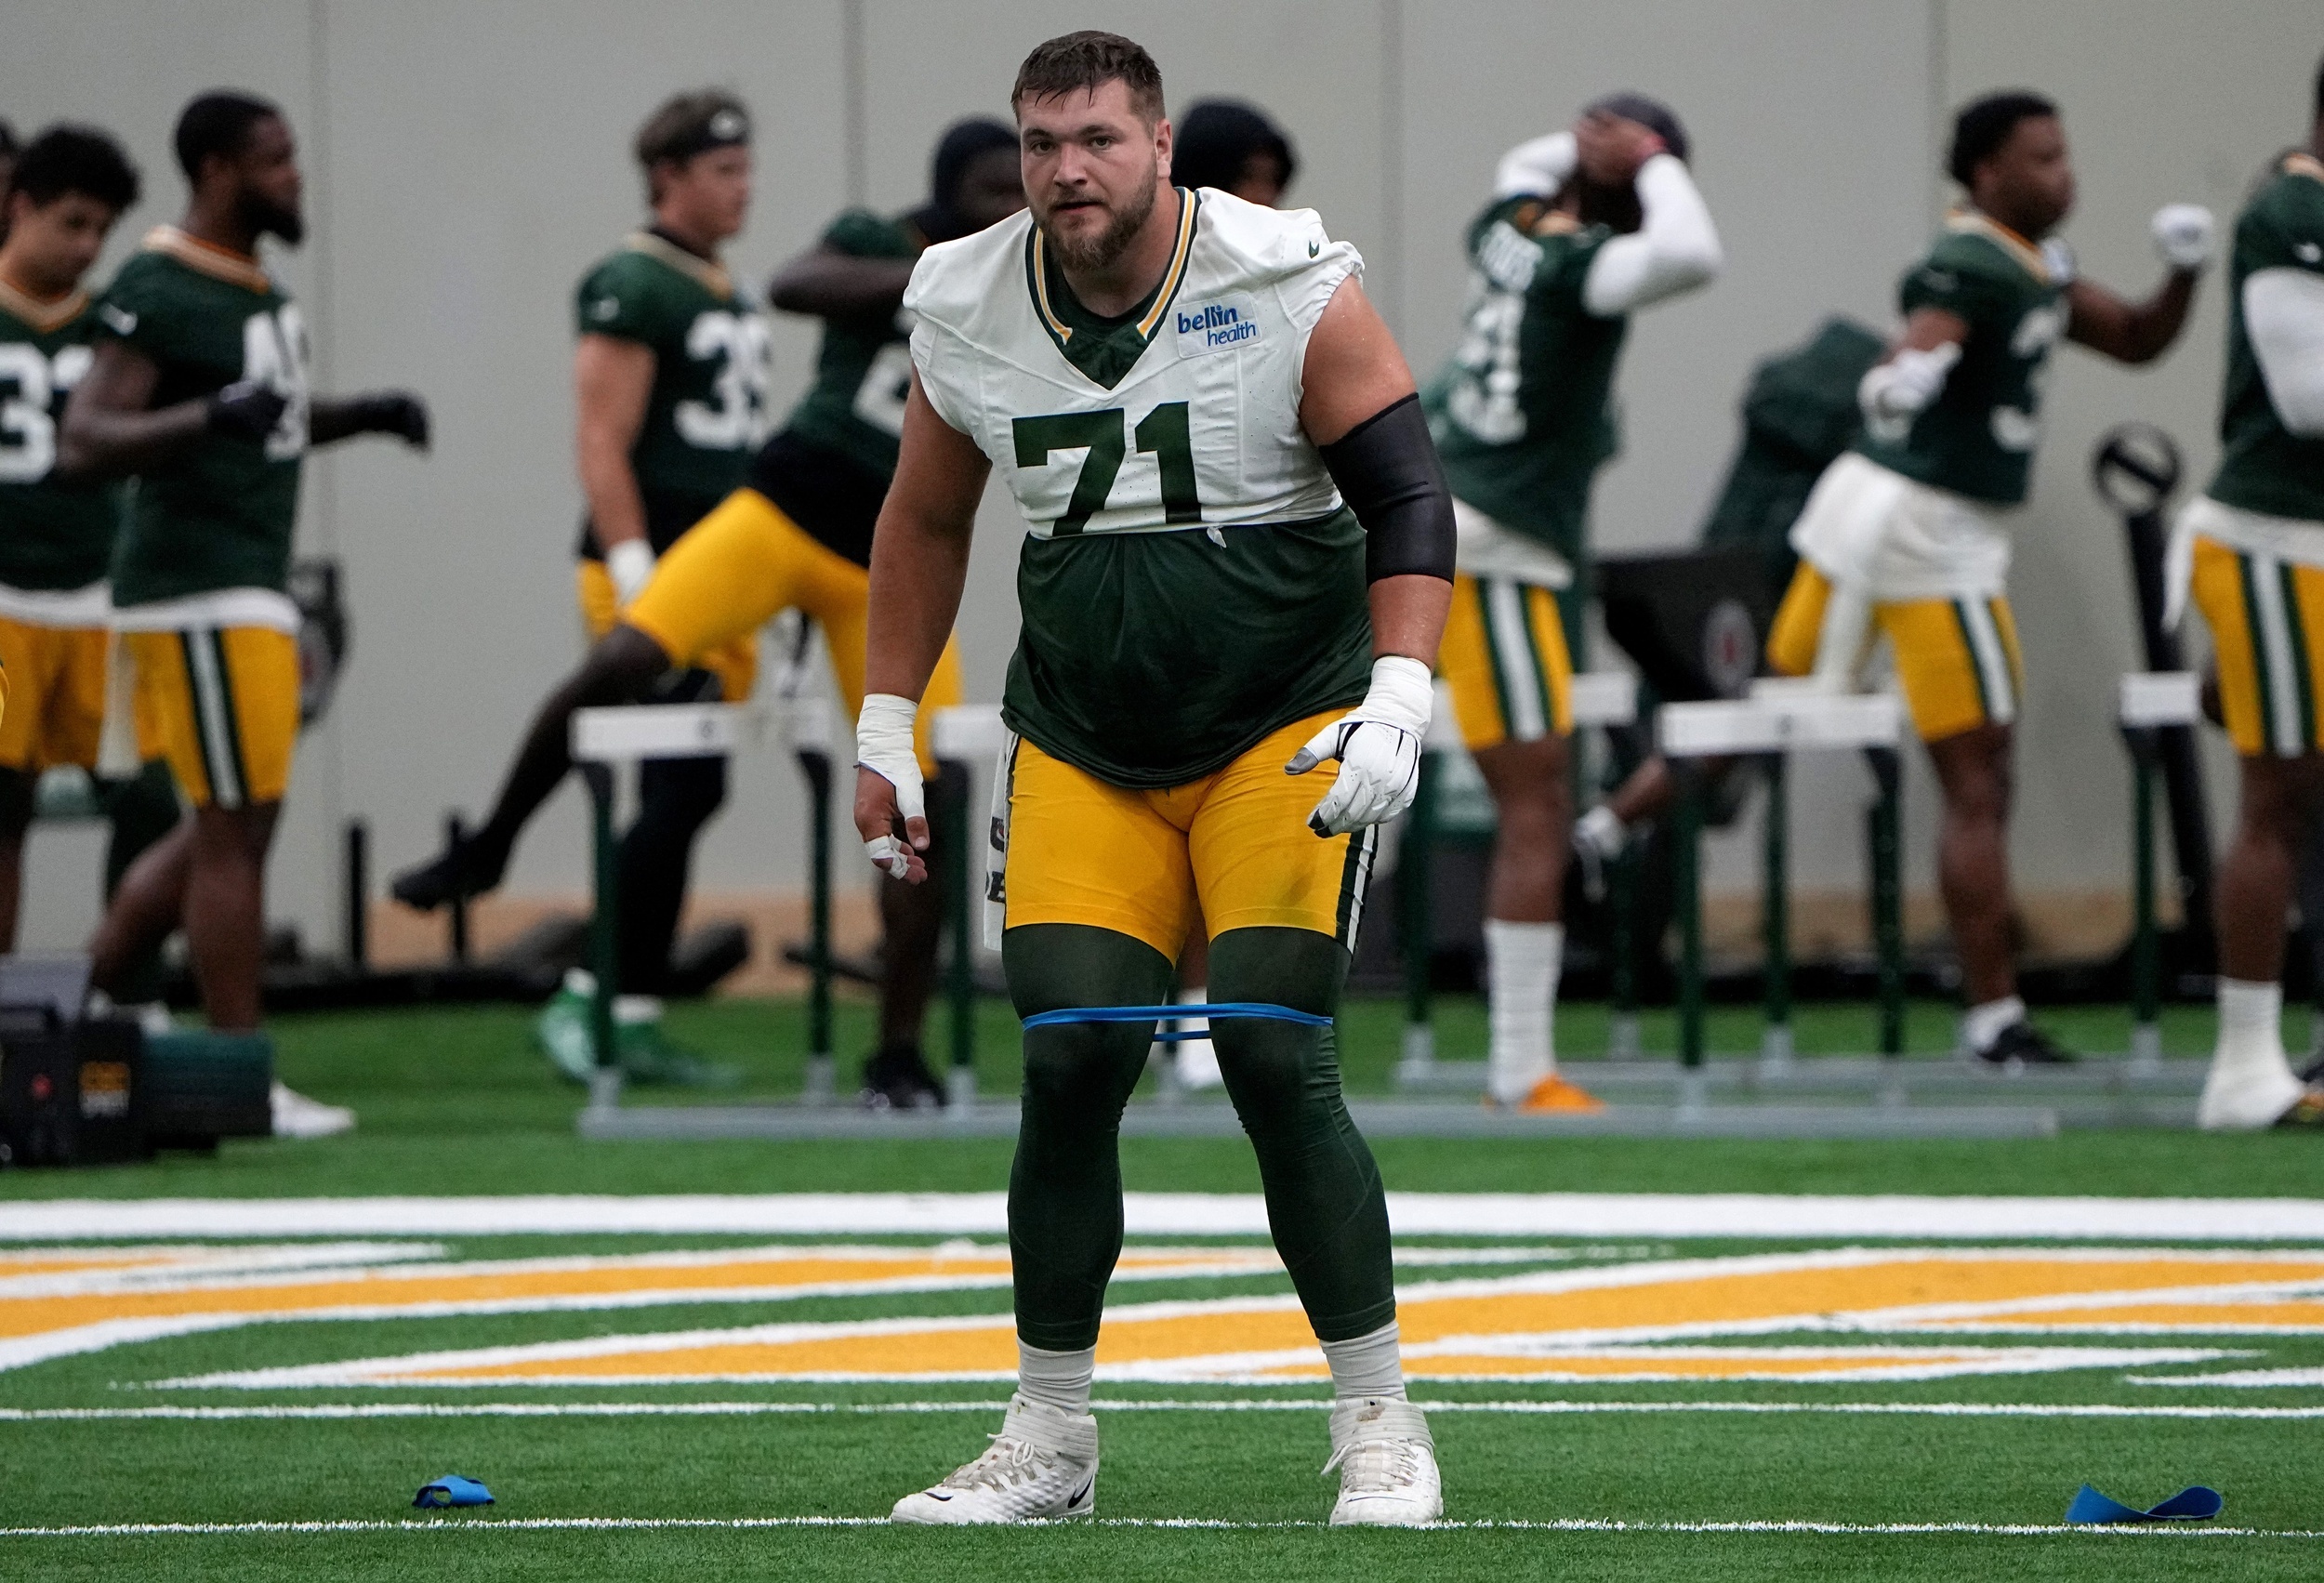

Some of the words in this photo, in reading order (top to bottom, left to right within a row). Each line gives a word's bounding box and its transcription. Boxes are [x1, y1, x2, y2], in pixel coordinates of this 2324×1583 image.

[1177, 304, 1238, 334] bellin
[1207, 321, 1257, 347] health
[1012, 401, 1202, 535] 71
